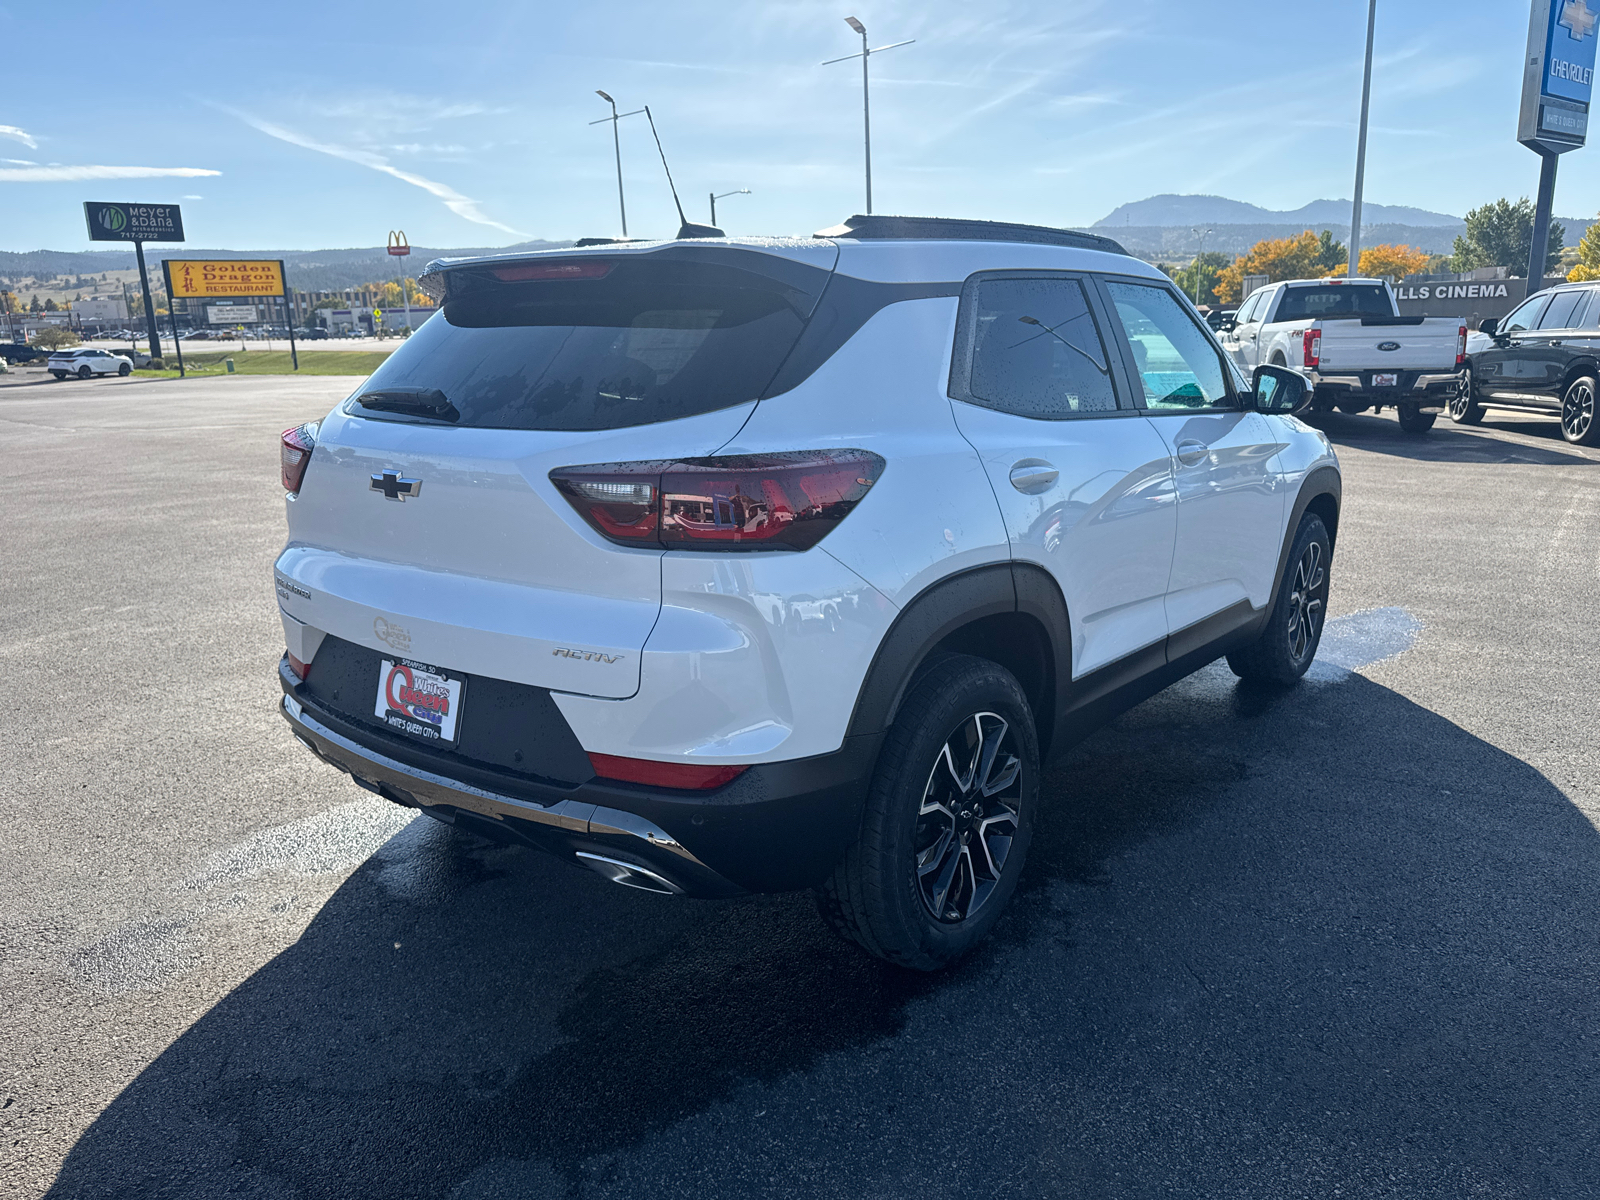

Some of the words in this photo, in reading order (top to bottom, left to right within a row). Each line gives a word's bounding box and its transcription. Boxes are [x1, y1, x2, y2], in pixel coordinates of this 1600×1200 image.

[1550, 58, 1593, 85] CHEVROLET
[129, 207, 171, 218] Meyer
[202, 264, 272, 272] Golden
[202, 272, 276, 282] Dragon
[205, 285, 275, 293] RESTAURANT
[1393, 287, 1430, 300] ILLS
[1435, 284, 1508, 299] CINEMA
[552, 646, 625, 664] ACTIV
[428, 666, 436, 674] SD
[386, 665, 450, 718] Queen
[413, 706, 443, 725] City
[388, 715, 406, 730] WHITE'S
[406, 721, 423, 735] QUEEN
[422, 727, 435, 739] CITY
